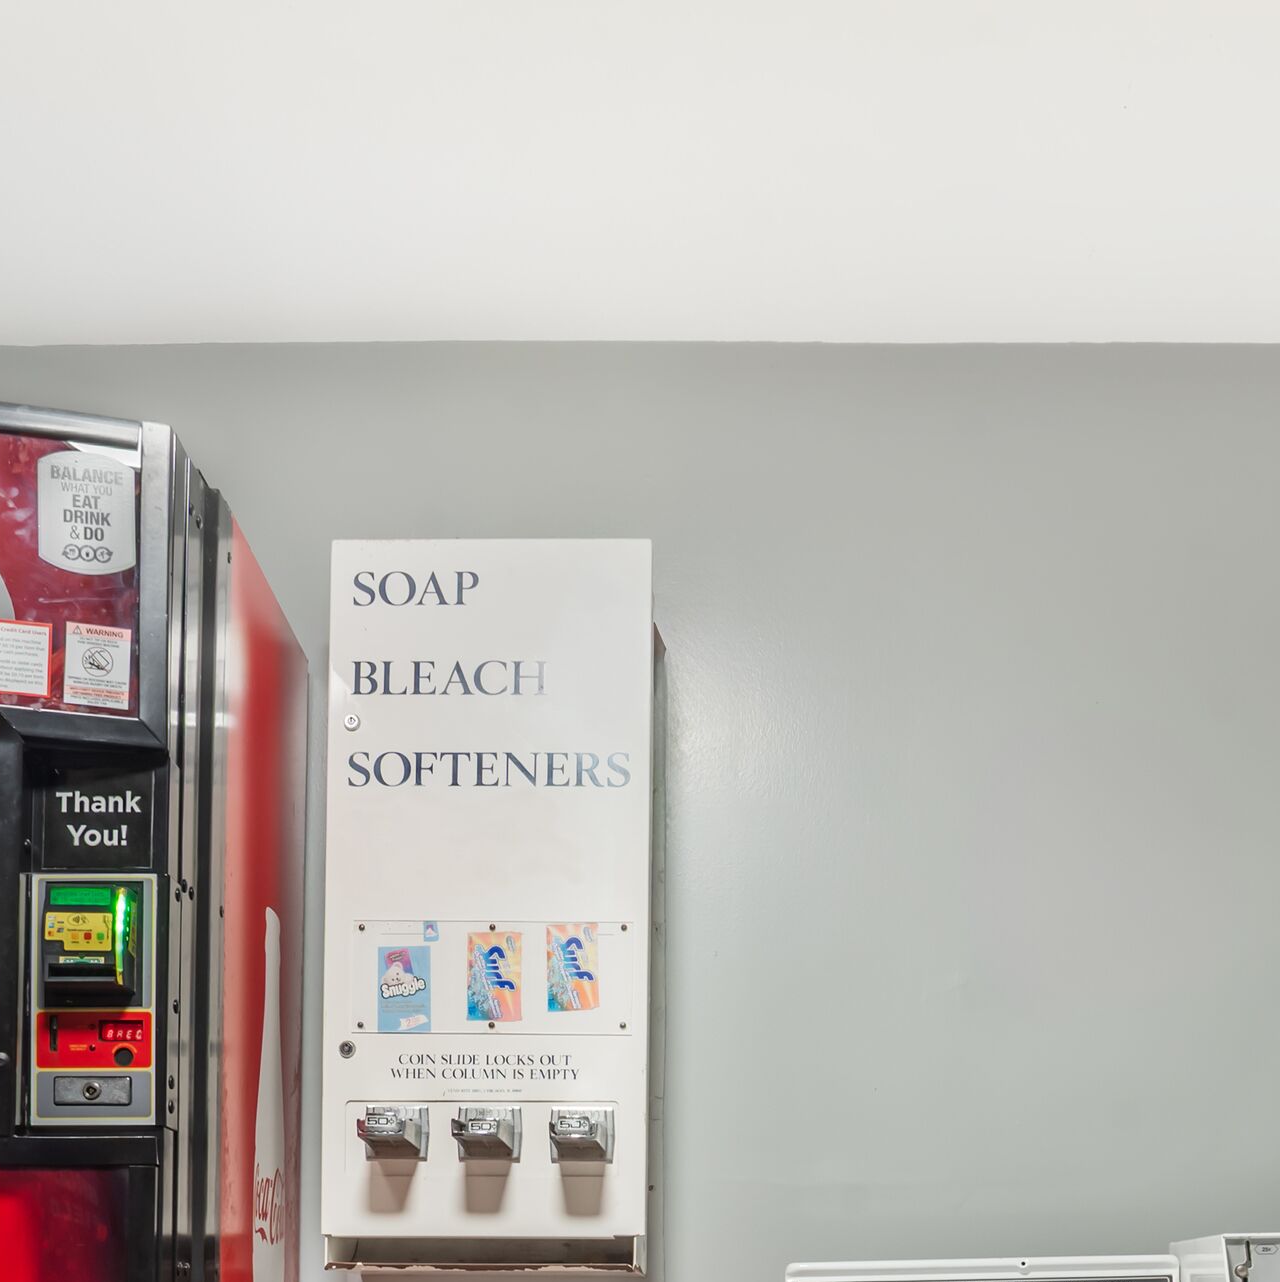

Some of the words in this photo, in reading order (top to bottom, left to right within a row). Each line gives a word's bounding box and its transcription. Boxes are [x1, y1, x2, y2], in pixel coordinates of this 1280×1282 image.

[50, 465, 124, 486] BALANCE
[60, 481, 89, 494] WHAT
[93, 484, 113, 497] YOU
[72, 494, 101, 510] EAT
[63, 509, 111, 527] DRINK
[70, 525, 80, 540] &
[83, 526, 104, 541] DO
[352, 571, 480, 607] SOAP
[85, 628, 124, 638] WARNING
[350, 660, 548, 696] BLEACH
[347, 751, 632, 788] SOFTENERS
[55, 790, 142, 813] Thank
[66, 824, 128, 847] You!
[380, 975, 427, 999] Snuggle
[398, 1053, 437, 1066] COIN
[440, 1053, 480, 1066] SLIDE
[485, 1053, 535, 1067] LOCKS
[539, 1054, 572, 1067] OUT
[390, 1067, 437, 1080] WHEN
[441, 1068, 507, 1081] COLUMN
[512, 1068, 525, 1080] IS
[530, 1068, 580, 1081] EMPTY
